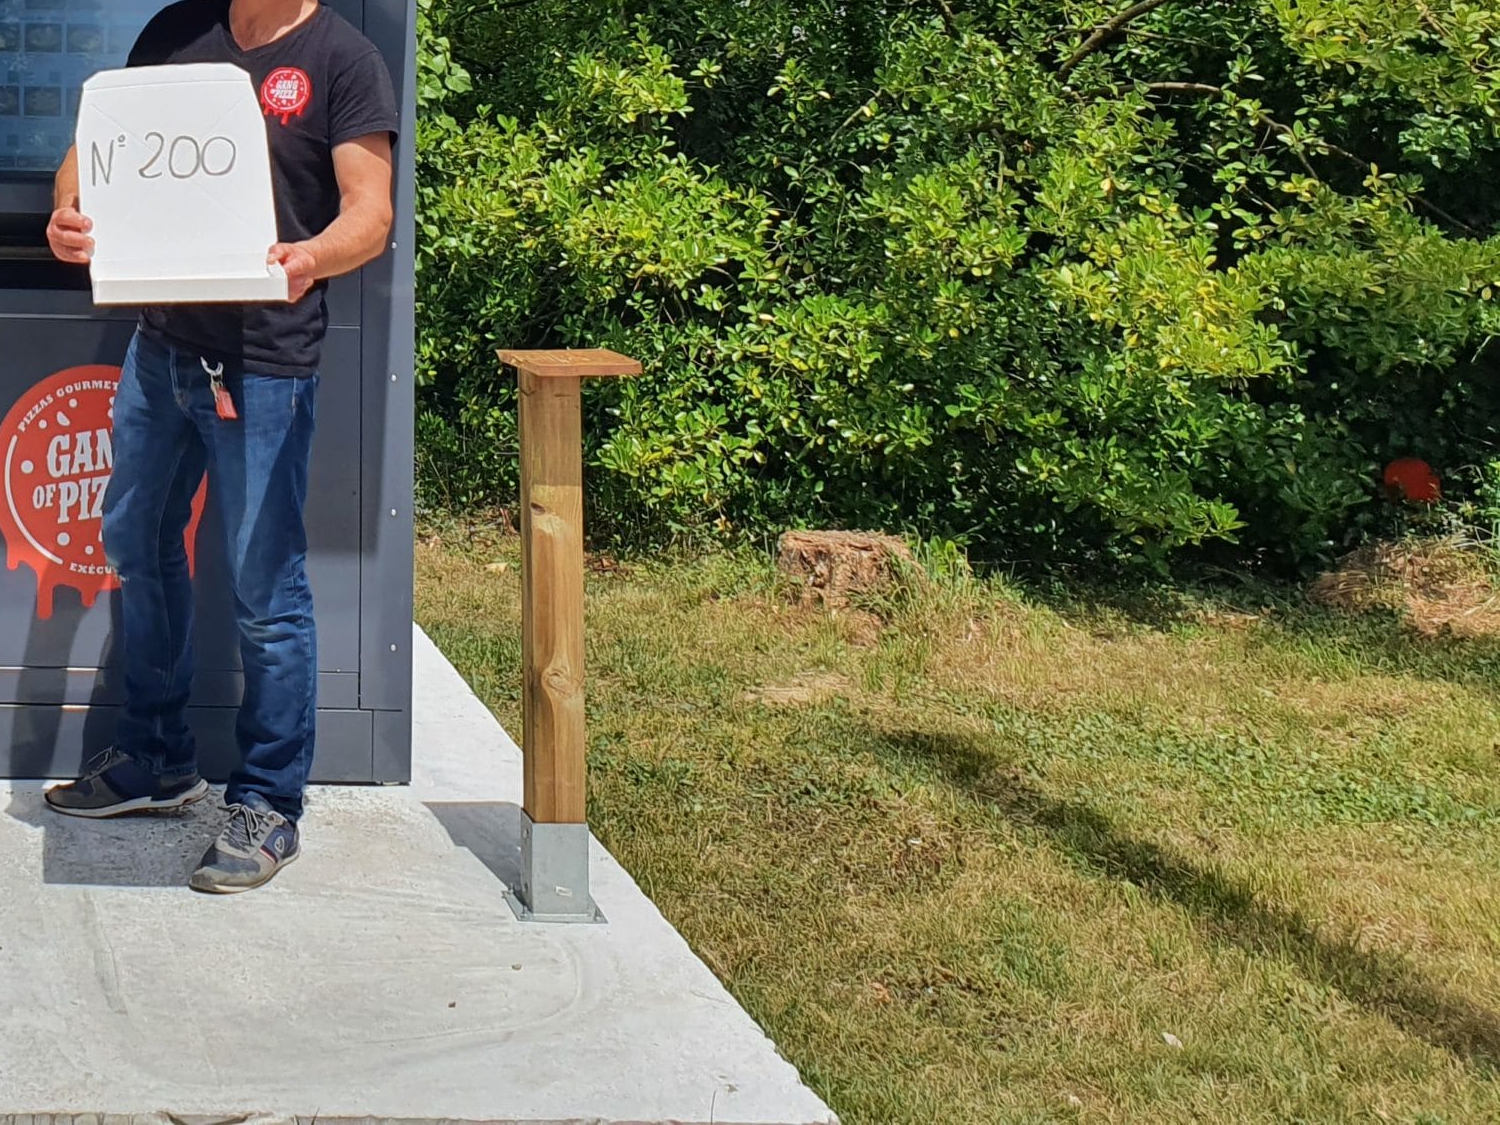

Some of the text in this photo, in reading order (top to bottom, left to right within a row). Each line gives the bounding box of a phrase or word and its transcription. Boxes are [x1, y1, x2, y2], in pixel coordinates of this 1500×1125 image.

[137, 130, 237, 180] 200
[17, 394, 54, 432] PIZZAS
[47, 428, 115, 478] GAN
[32, 475, 112, 524] OF PIZ
